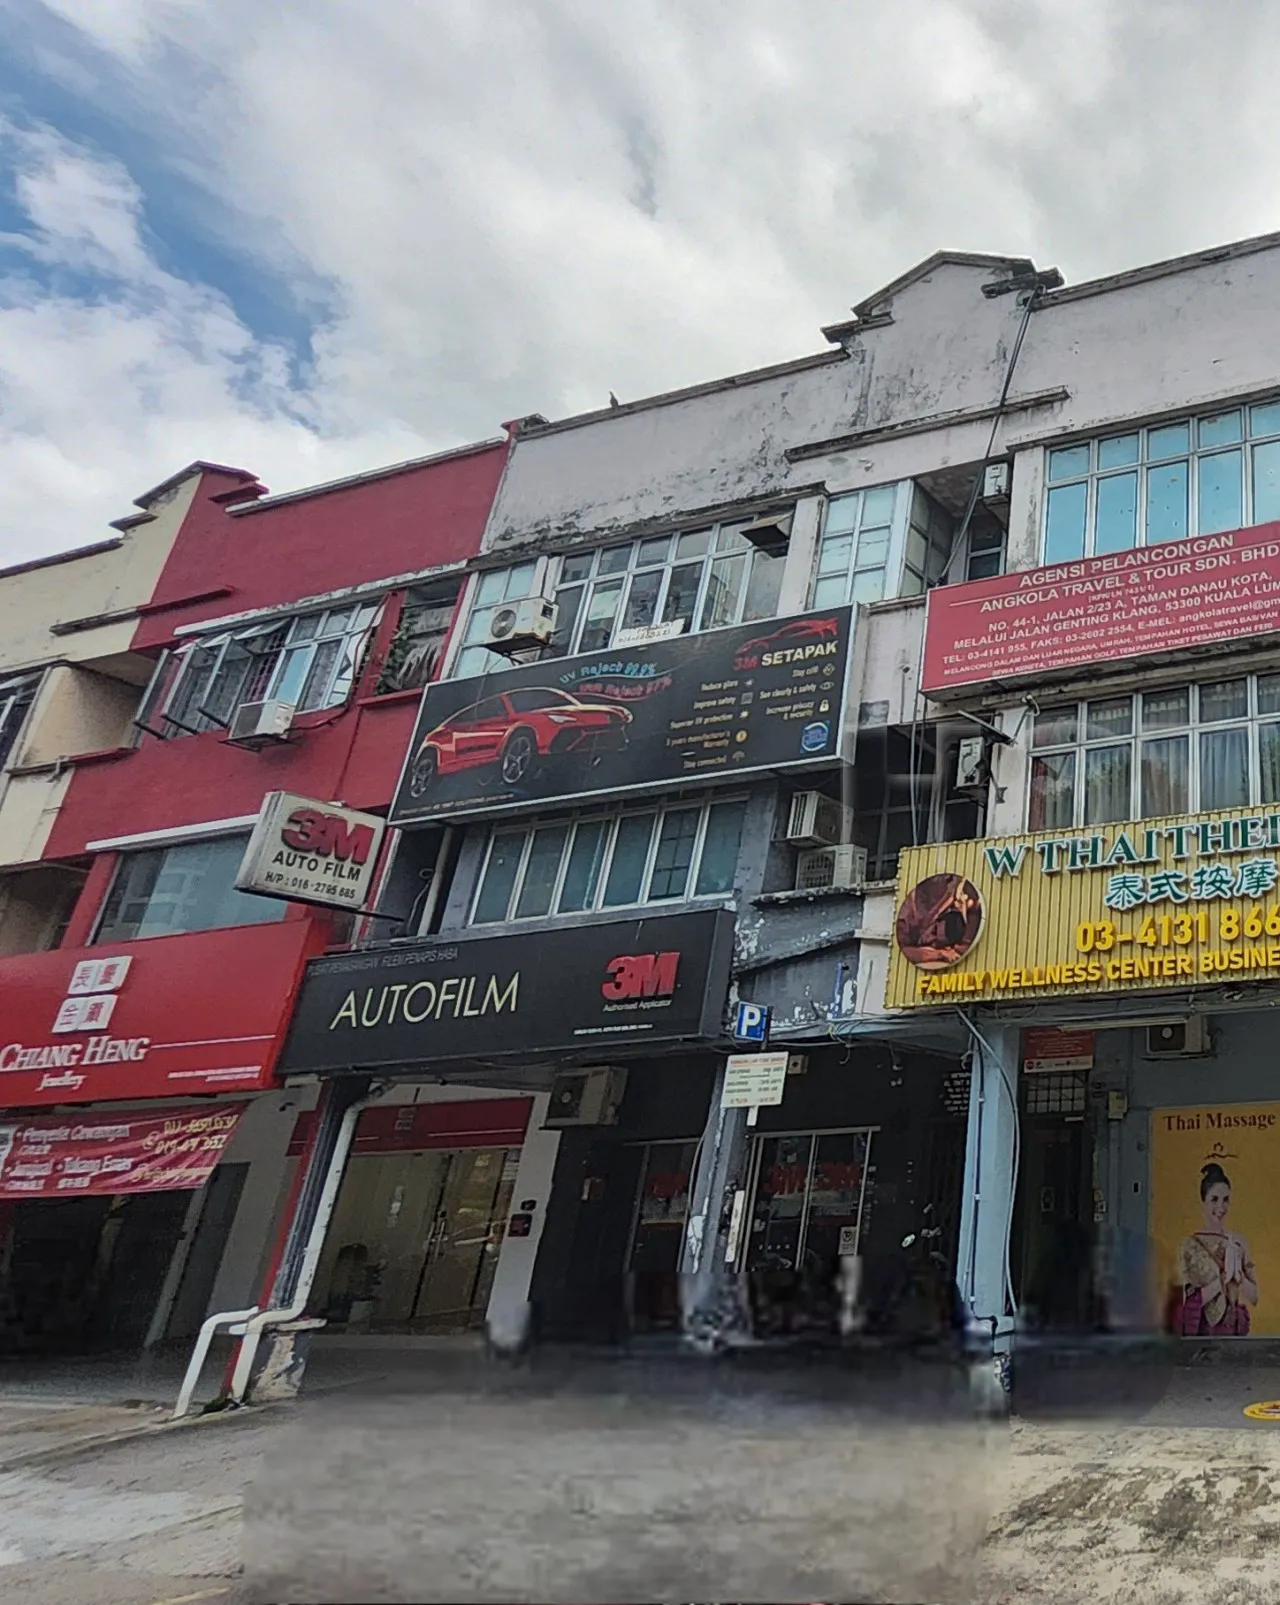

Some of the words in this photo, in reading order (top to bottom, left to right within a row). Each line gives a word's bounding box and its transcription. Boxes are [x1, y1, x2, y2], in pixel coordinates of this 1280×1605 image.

[980, 590, 1059, 613] ANGKOLA
[1063, 574, 1125, 597] TRAVEL
[1129, 572, 1140, 585] &
[1144, 562, 1192, 582] TOUR
[1195, 554, 1237, 572] SDN.
[1019, 564, 1085, 588] AGENSI
[1091, 534, 1234, 574] PELANCONGAN
[954, 631, 1007, 650] MELALUI
[1009, 624, 1050, 641] JALAN
[1053, 614, 1109, 632] GENTING
[1112, 604, 1162, 621] KLANG,
[1164, 597, 1201, 611] 53300
[1204, 586, 1251, 604] KUALA
[989, 622, 1009, 632] NO.
[1043, 604, 1084, 623] JALAN
[1087, 602, 1112, 615] 2/23
[1131, 588, 1177, 606] TAMAN
[1180, 580, 1228, 597] DANAU
[1231, 571, 1273, 587] KOTA,
[761, 640, 839, 666] SETAPAK
[942, 654, 965, 665] TEL:
[967, 646, 1005, 661] 03-4141
[1031, 636, 1063, 650] FAKS:
[1065, 629, 1105, 643] 03-2602
[1138, 616, 1178, 630] E-MEL:
[994, 656, 1021, 667] DALAM
[1022, 652, 1040, 662] DAN
[1134, 628, 1181, 643] TEMPAHAN
[1213, 618, 1238, 629] SEWA
[1048, 653, 1093, 667] TEMPAHAN
[1119, 641, 1165, 656] TEMPAHAN
[1167, 636, 1192, 646] TIKET
[1191, 629, 1233, 643] PESAWAT
[1233, 626, 1252, 636] DAN
[560, 670, 577, 684] UV
[580, 661, 623, 677] Reject
[281, 806, 376, 866] 3M
[265, 871, 284, 883] H/P
[272, 850, 319, 872] AUTO
[323, 861, 361, 882] FILM
[984, 844, 1028, 877] W
[1104, 857, 1280, 910] 泰式按摩
[1075, 909, 1208, 954] 03-4131
[602, 951, 680, 1001] 3M
[916, 970, 984, 996] FAMILY
[989, 960, 1101, 989] WELLNESS
[1106, 952, 1193, 982] CENTER
[329, 971, 521, 1031] AUTOFILM
[742, 1006, 761, 1036] P
[0, 1043, 82, 1072] CHIANG
[80, 1035, 150, 1066] HENG
[1163, 1114, 1201, 1132] Thai
[1205, 1111, 1276, 1132] Massage
